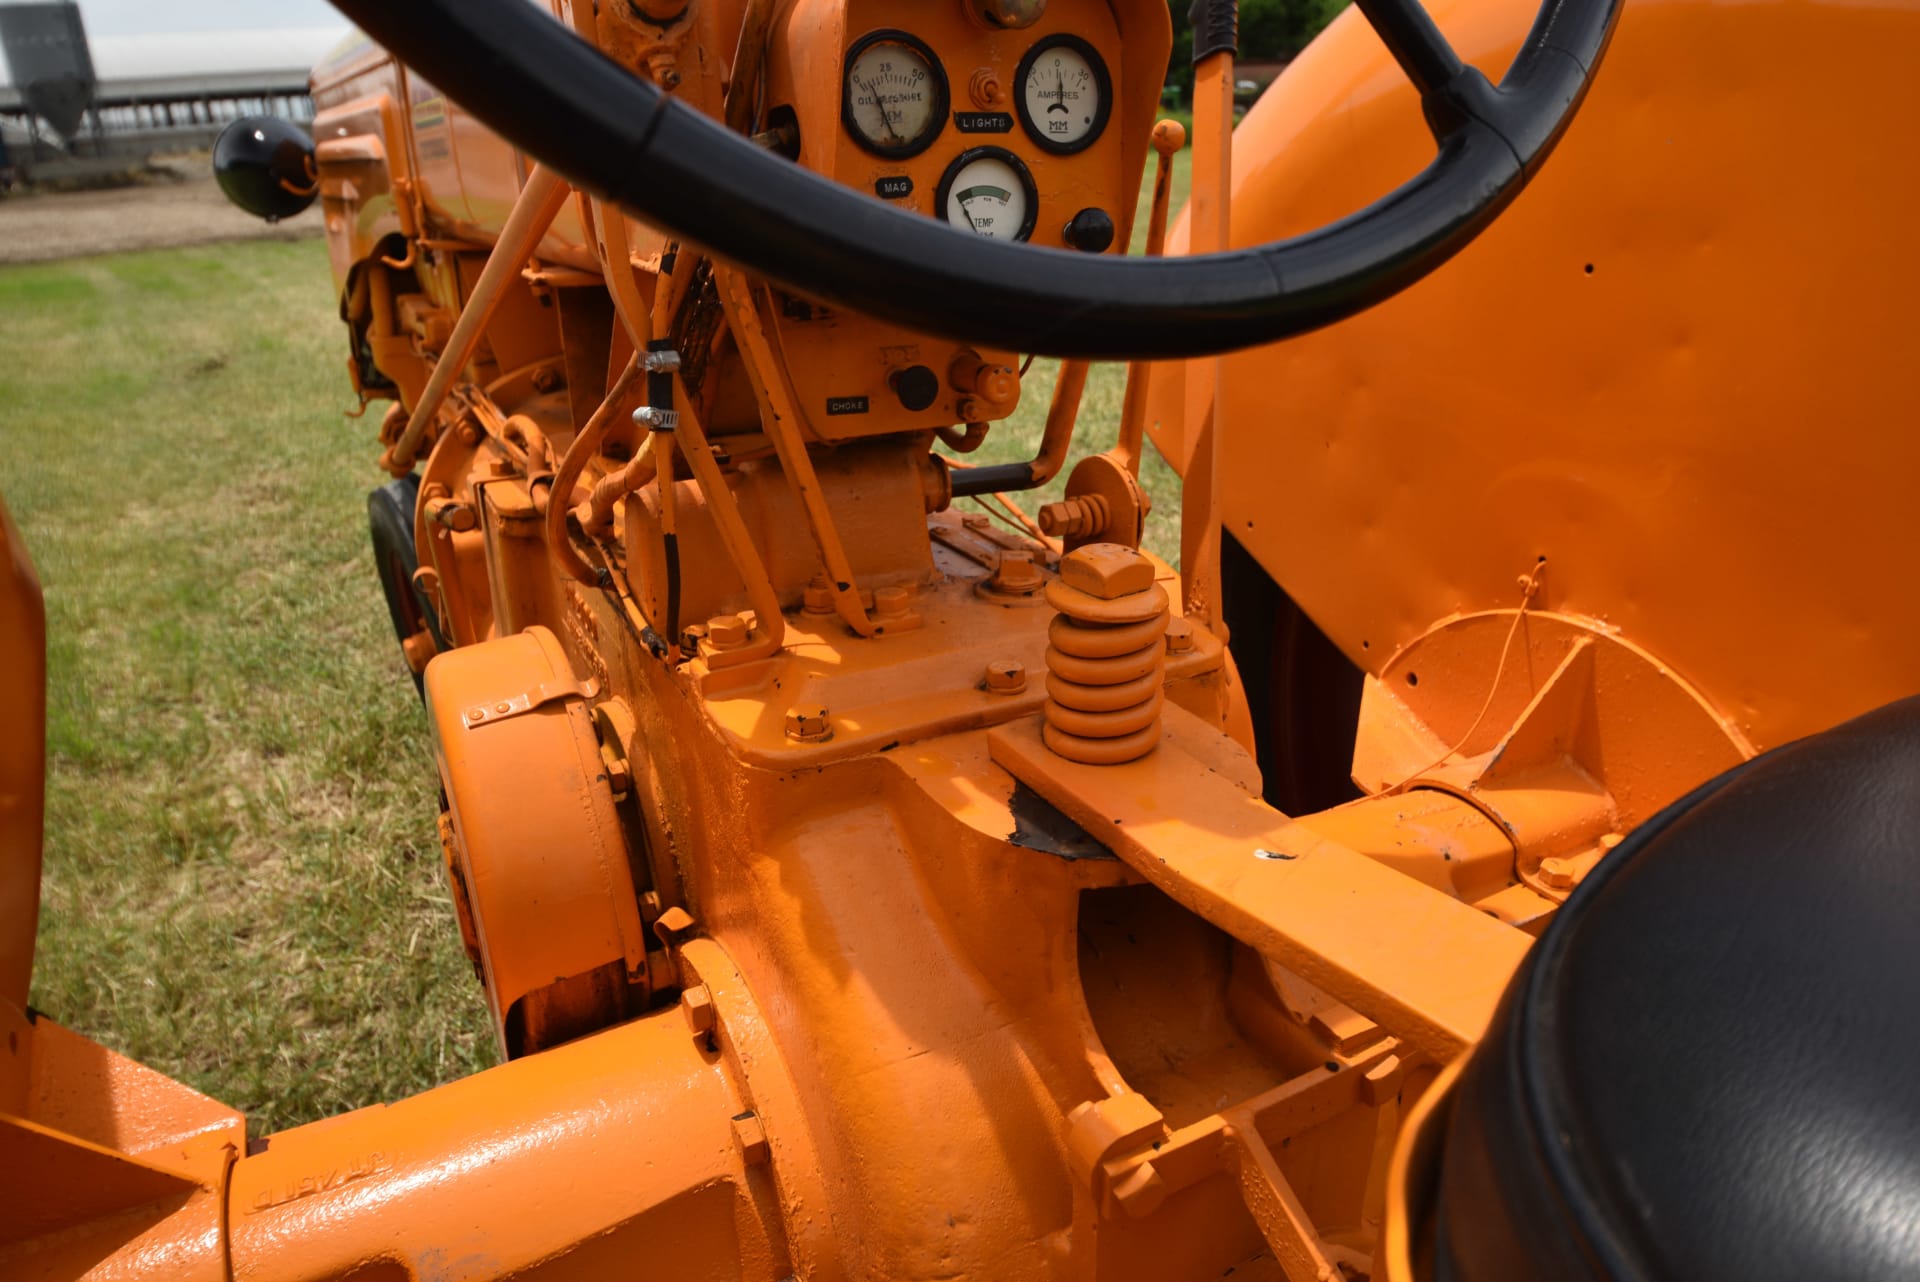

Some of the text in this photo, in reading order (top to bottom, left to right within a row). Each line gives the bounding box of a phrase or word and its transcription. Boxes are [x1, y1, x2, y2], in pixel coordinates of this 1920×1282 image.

[880, 63, 892, 72] 25
[911, 68, 925, 81] 50
[1037, 90, 1079, 100] AMPERES
[857, 96, 874, 105] OIL
[962, 118, 1006, 128] LIGHTS
[1048, 120, 1069, 131] MM
[884, 183, 907, 193] MAG
[974, 218, 994, 228] TEMP
[832, 402, 864, 411] CHOKE
